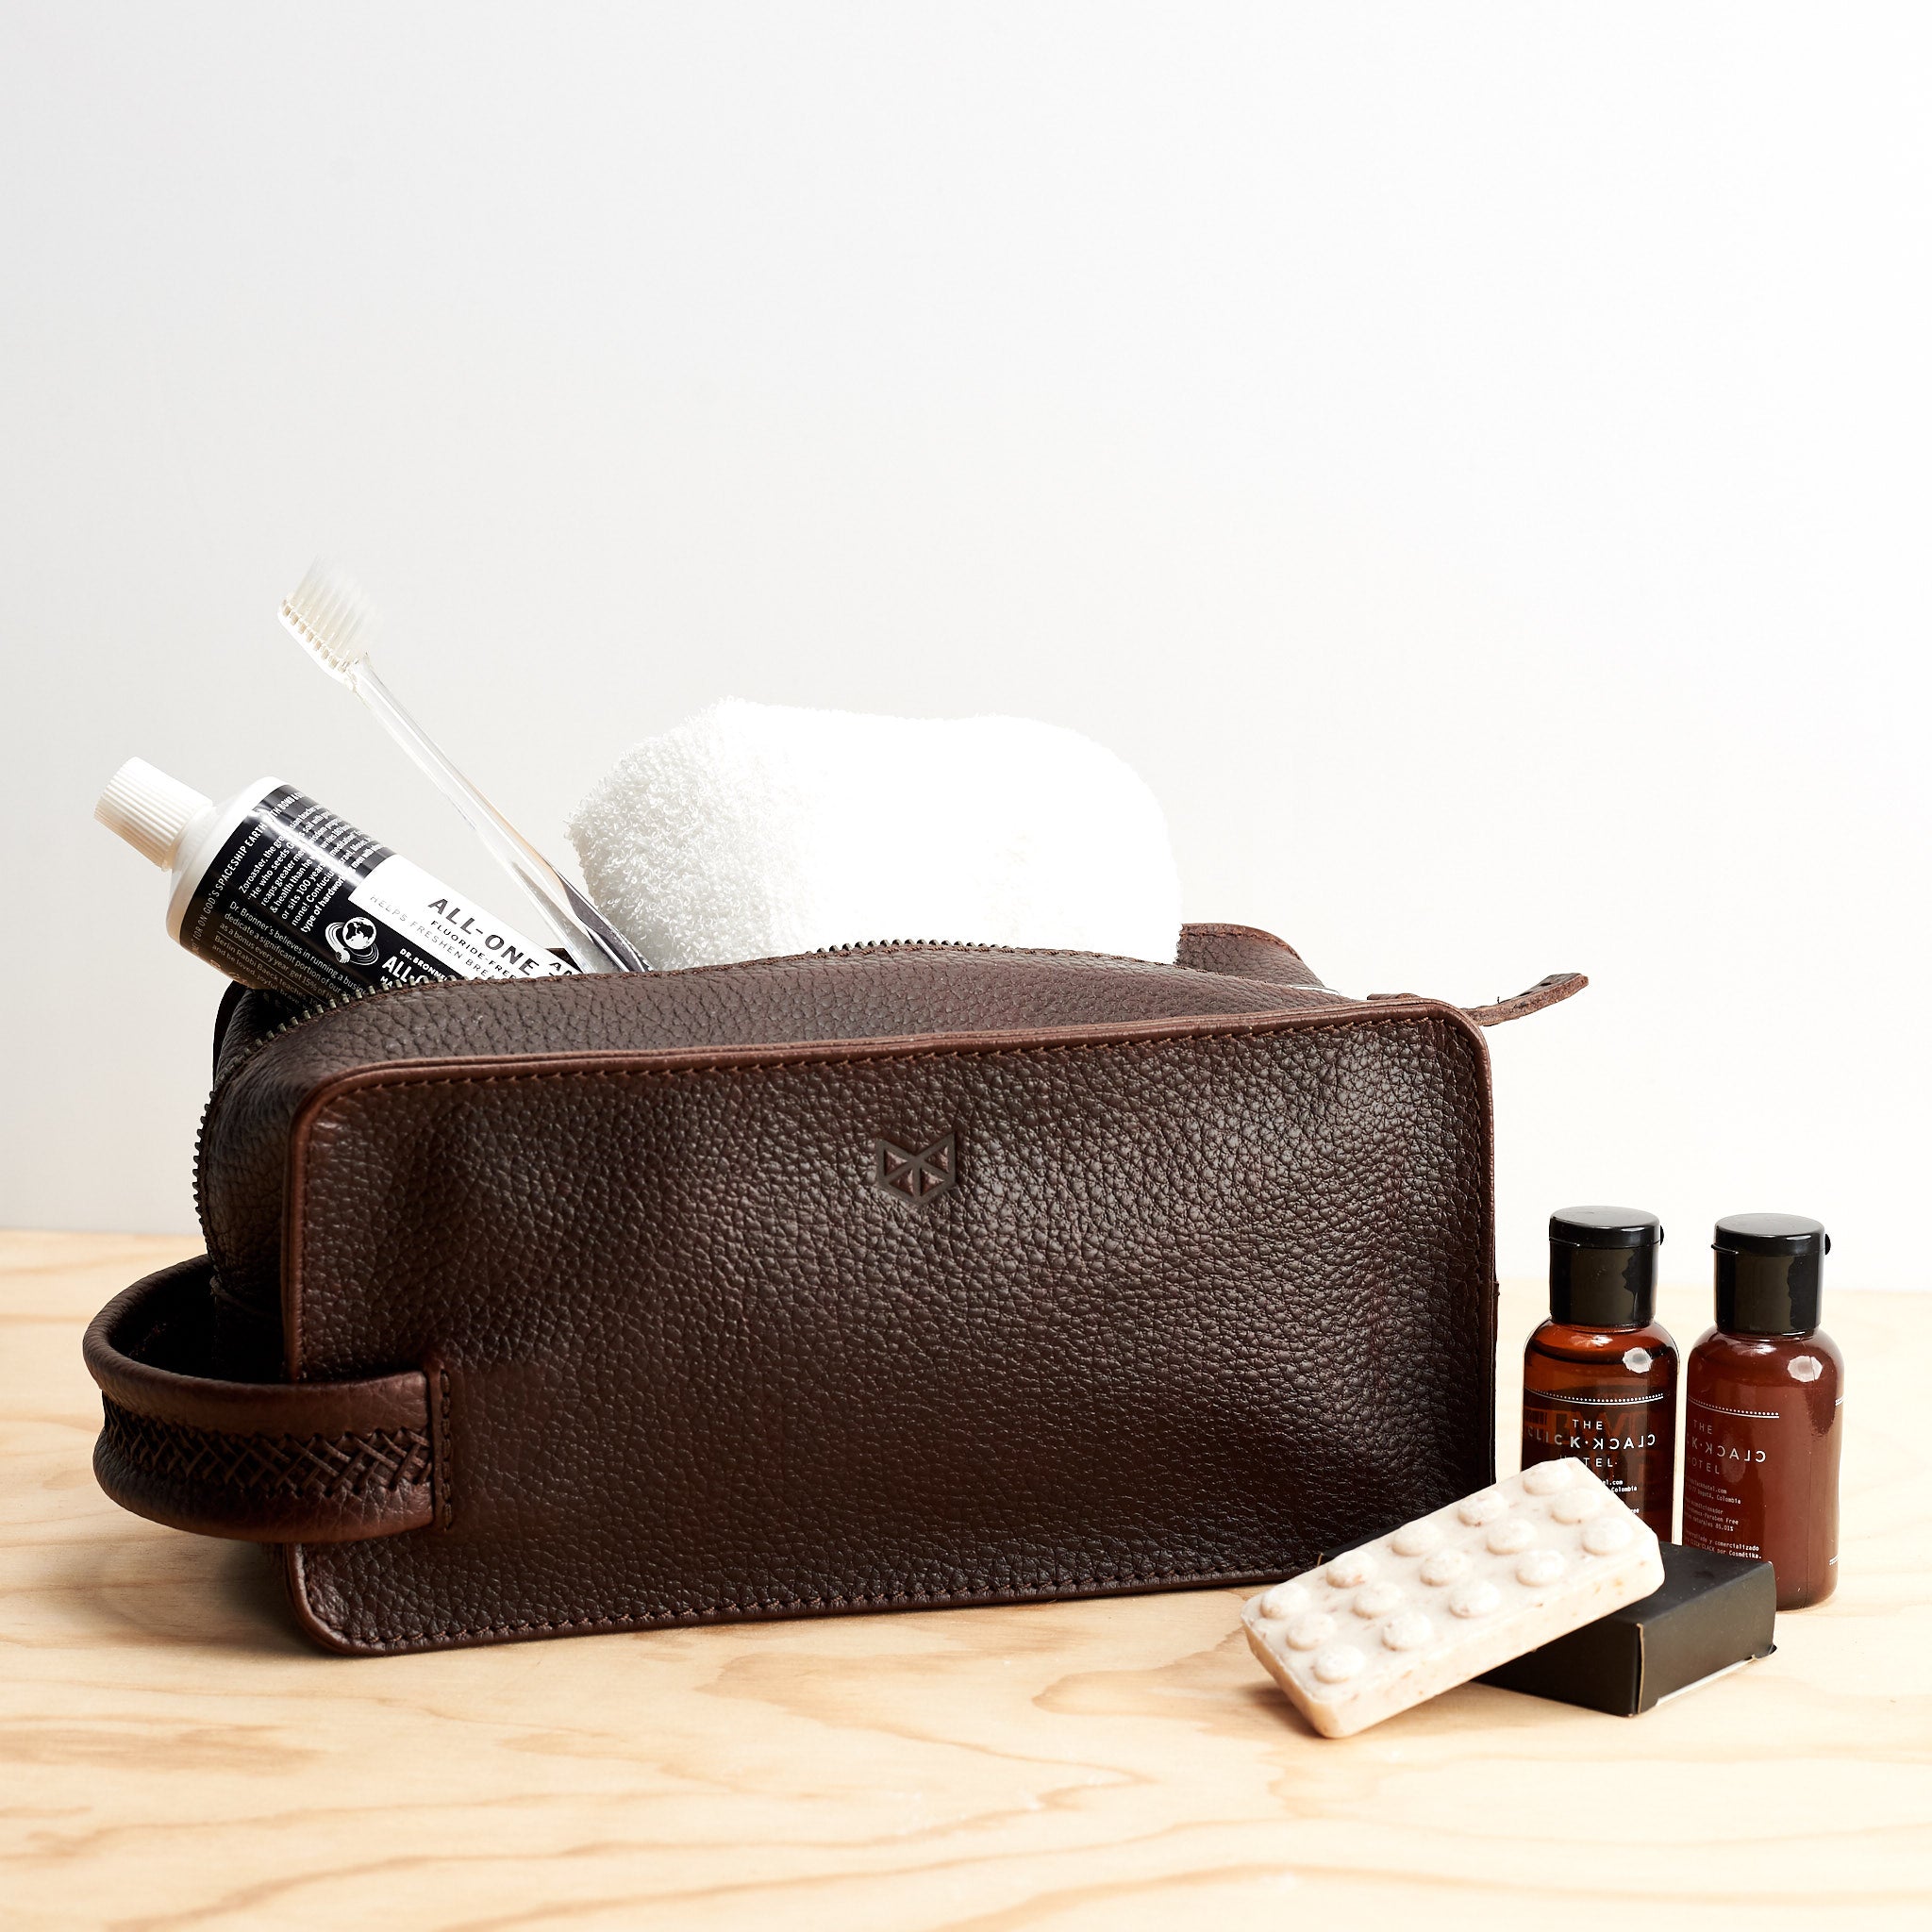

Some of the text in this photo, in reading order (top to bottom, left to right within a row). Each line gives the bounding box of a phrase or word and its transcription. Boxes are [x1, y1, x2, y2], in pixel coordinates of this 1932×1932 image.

[245, 823, 267, 846] EARTH
[214, 844, 247, 891] SPACESHIP
[238, 857, 268, 893] Zoroaster,
[262, 845, 276, 858] the
[274, 832, 287, 848] gre
[258, 869, 274, 886] who
[270, 847, 290, 871] seeds
[289, 866, 306, 884] than
[300, 858, 313, 869] he
[260, 884, 277, 907] reaps
[274, 859, 295, 887] greater
[273, 882, 294, 907] health
[281, 909, 290, 920] or
[287, 893, 301, 910] sits
[295, 878, 311, 895] 100
[309, 861, 325, 882] years
[299, 914, 317, 933] type
[312, 904, 323, 915] of
[351, 854, 365, 869] men
[202, 889, 220, 914] GOD'S
[269, 905, 278, 913] &
[291, 901, 309, 926] none!
[197, 914, 208, 926] ON
[370, 895, 407, 922] HELPS
[409, 921, 463, 959] FRESHEN
[228, 900, 240, 912] Dr.
[239, 907, 275, 935] Bronner's
[273, 929, 303, 954] believes
[302, 948, 310, 959] in
[309, 955, 339, 979] running
[427, 898, 539, 975] ALL-ONE
[211, 943, 226, 956] and
[225, 952, 236, 962] be
[213, 934, 236, 953] Berlin
[235, 948, 257, 967] Rabbi
[256, 962, 278, 981] Baeck
[219, 923, 228, 932] as
[232, 930, 256, 949] bonus
[254, 945, 275, 962] every
[289, 969, 302, 980] get
[301, 975, 318, 991] 15%
[316, 987, 326, 996] of
[224, 912, 255, 936] dedicate
[258, 935, 296, 963] significant
[293, 959, 322, 980] portion
[320, 976, 330, 986] of
[327, 982, 341, 993] our
[400, 948, 412, 960] DR.
[1572, 1419, 1603, 1430] THE
[1693, 1419, 1712, 1434] THE
[1688, 1457, 1720, 1474] OTEL
[1716, 1494, 1741, 1505] Colombia
[1725, 1517, 1739, 1525] Free
[1714, 1541, 1759, 1552] comercializado
